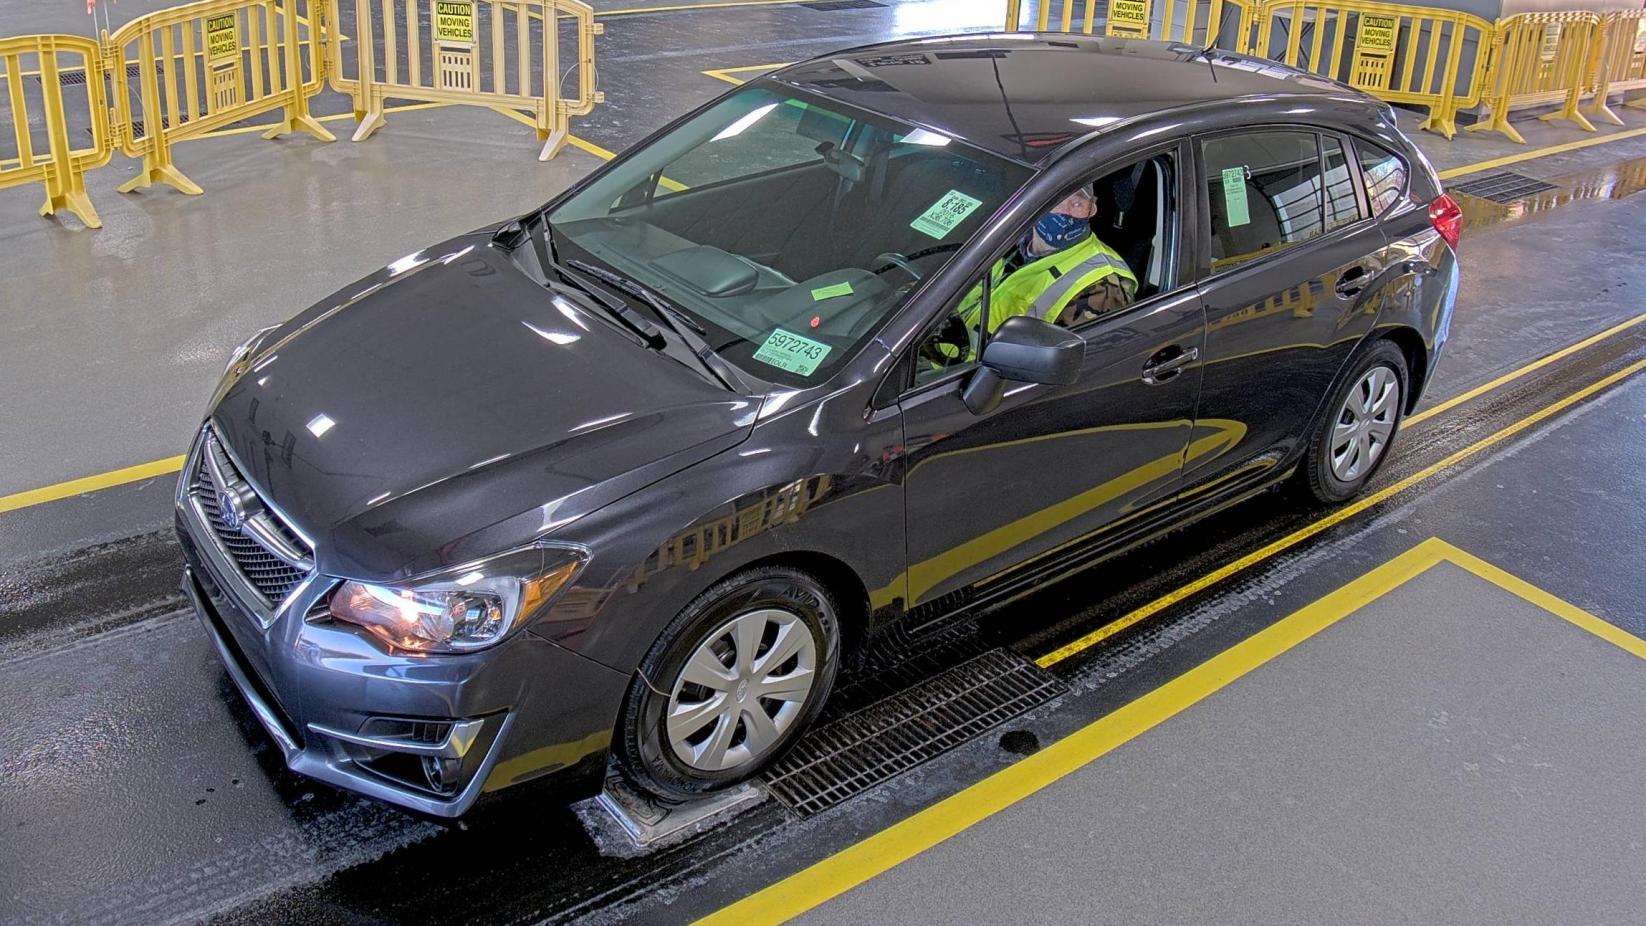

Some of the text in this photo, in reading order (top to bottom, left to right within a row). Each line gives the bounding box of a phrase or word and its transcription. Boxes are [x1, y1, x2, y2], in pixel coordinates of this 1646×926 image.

[438, 3, 471, 15] CAUTION
[1116, 2, 1143, 12] MOVING
[1112, 11, 1144, 20] VEHICLES
[440, 17, 470, 27] MOVING
[1364, 17, 1393, 27] CAUTION
[211, 31, 233, 44] MOVING
[439, 28, 472, 37] VEHICLES
[1365, 29, 1391, 37] MOVING
[1361, 37, 1391, 46] VEHICLES
[210, 41, 236, 55] VEHICLES
[768, 333, 823, 360] 5972743
